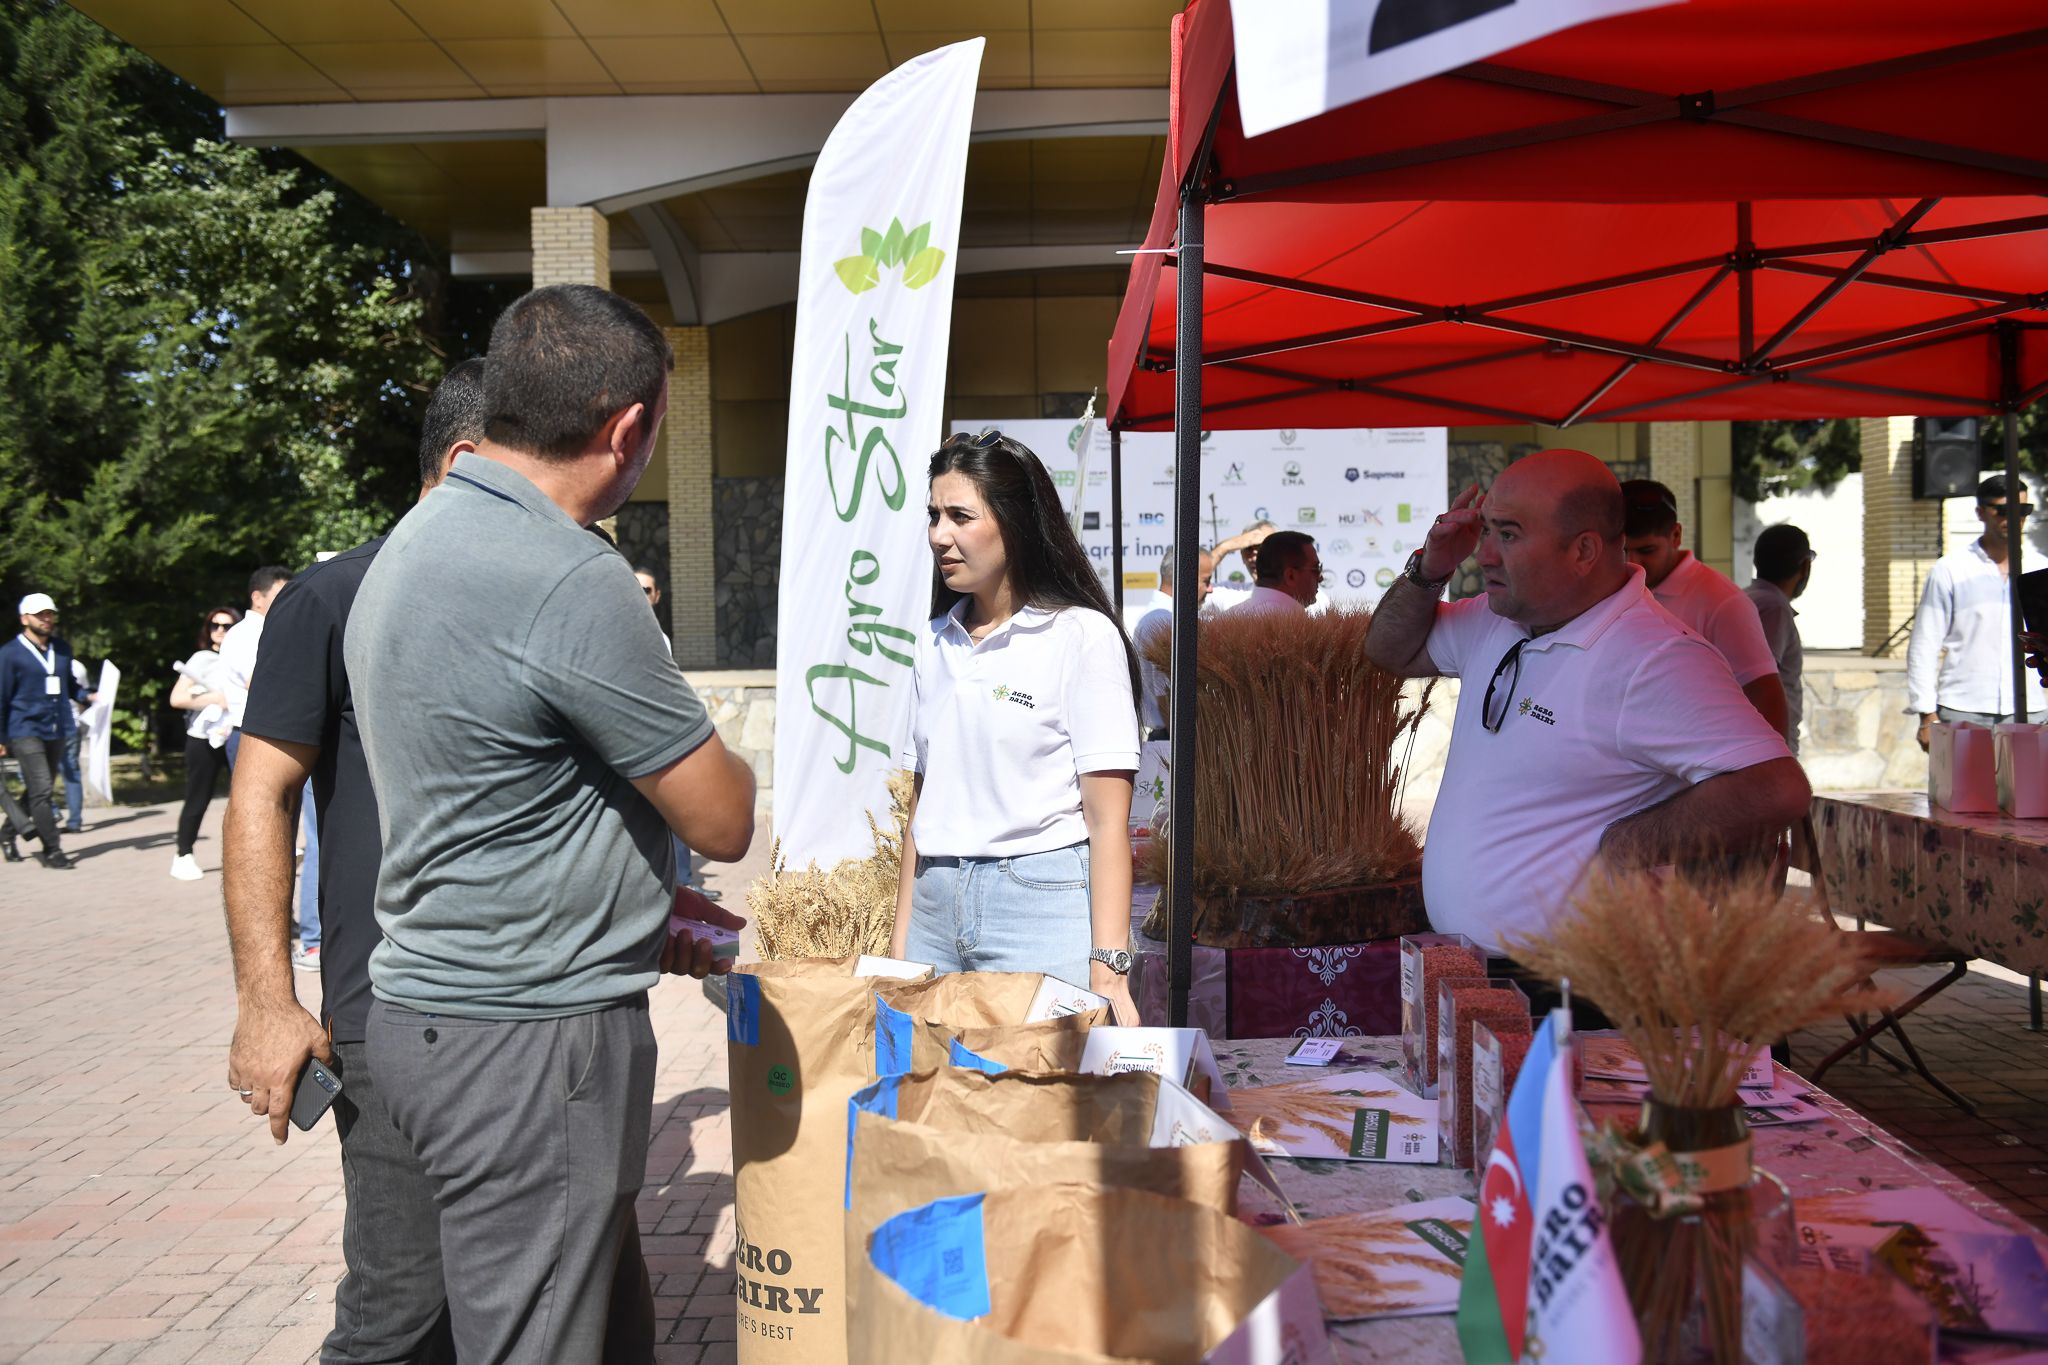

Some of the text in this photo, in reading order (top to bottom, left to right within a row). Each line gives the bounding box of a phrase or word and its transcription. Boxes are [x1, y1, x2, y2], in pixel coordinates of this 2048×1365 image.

[805, 317, 916, 775] Agro Star
[773, 1071, 787, 1080] QC
[737, 1273, 823, 1314] AIRY
[761, 1322, 793, 1341] BEST
